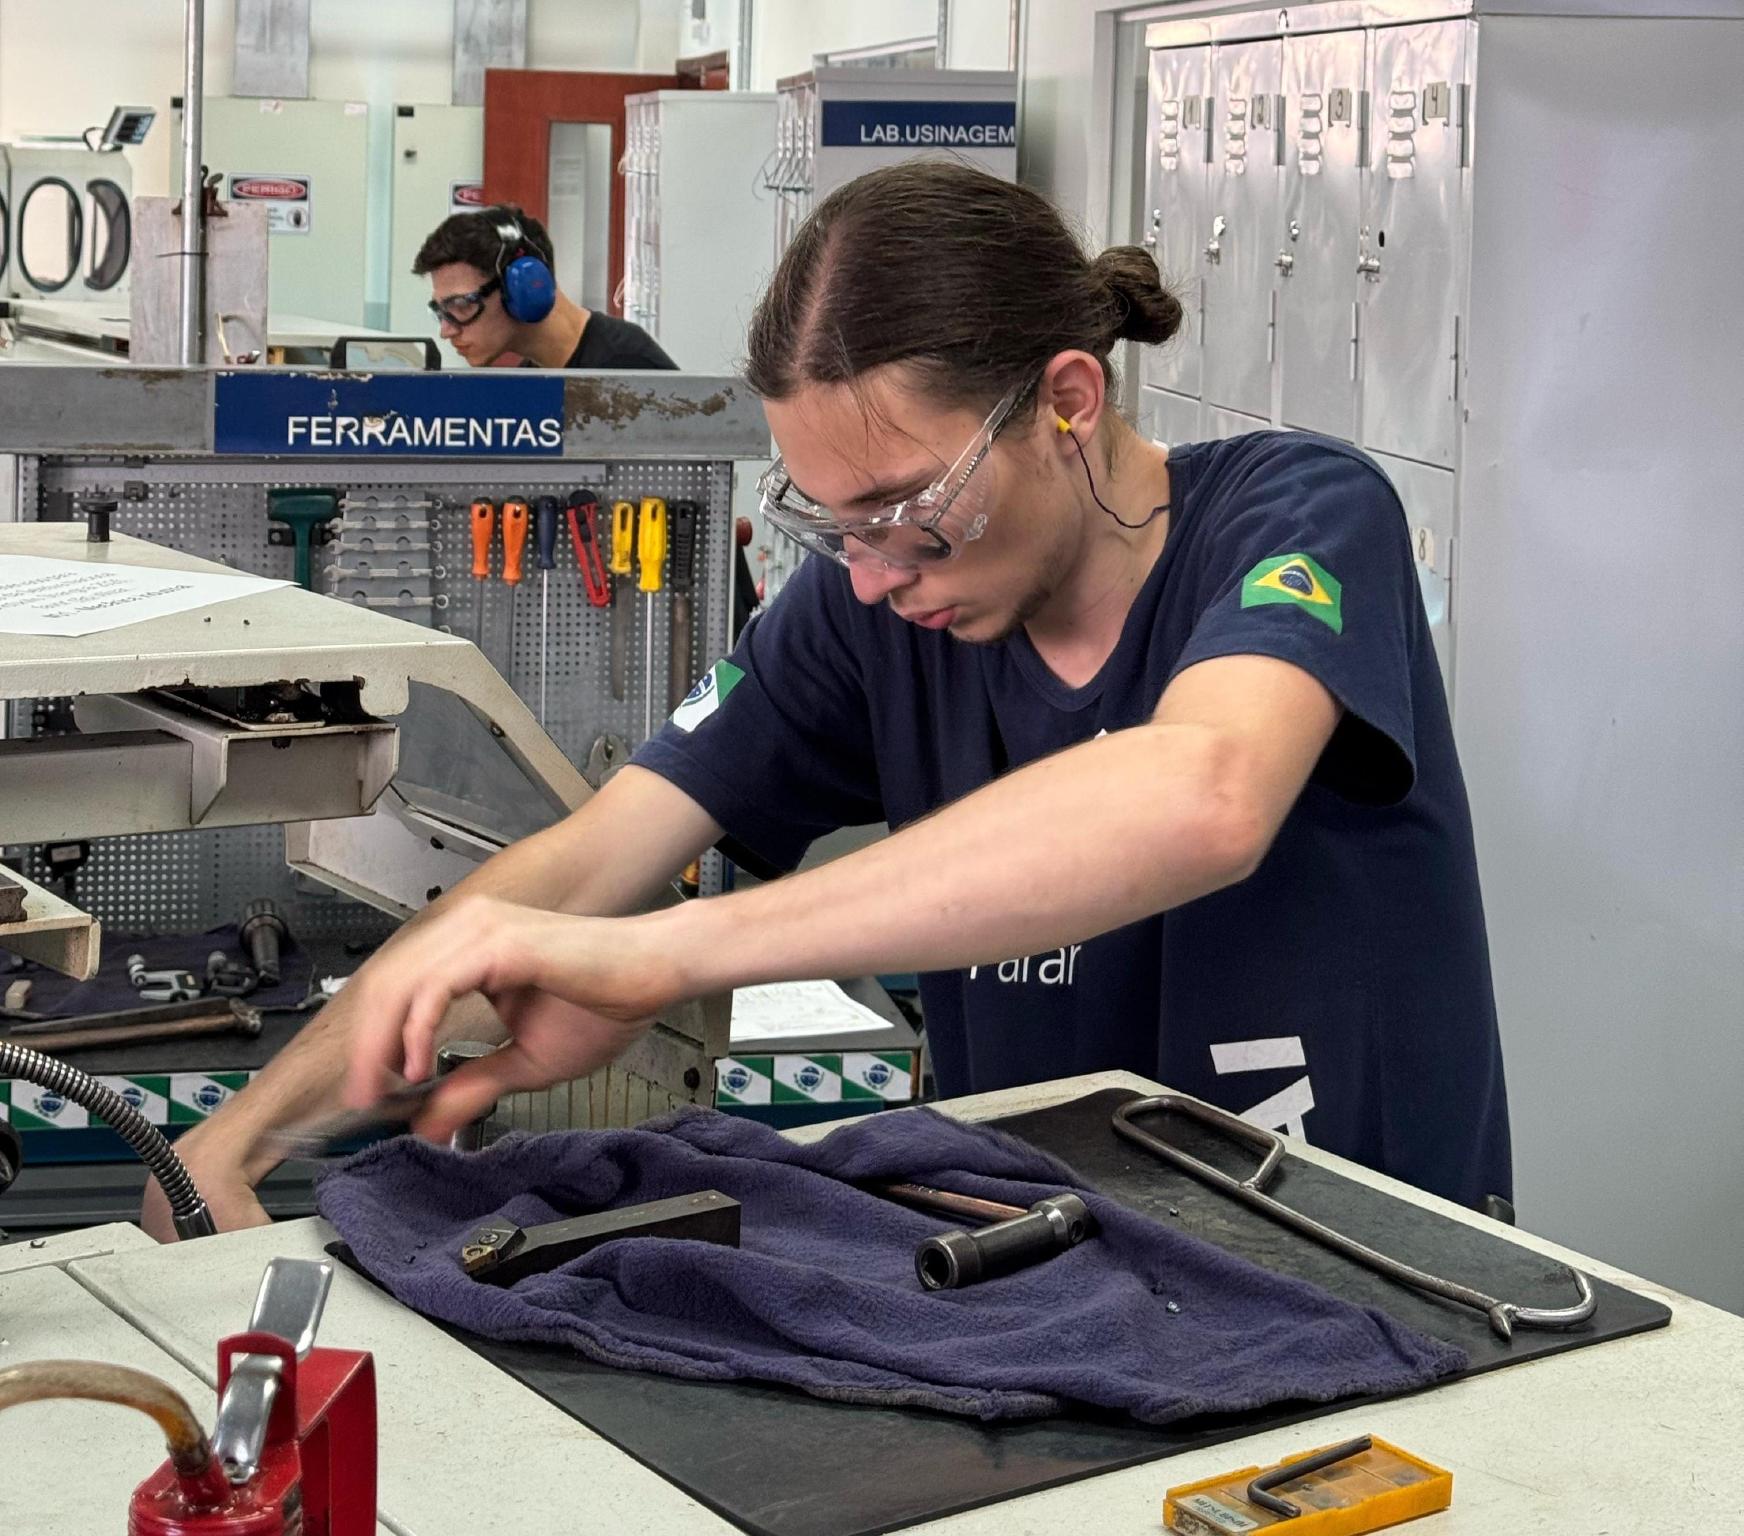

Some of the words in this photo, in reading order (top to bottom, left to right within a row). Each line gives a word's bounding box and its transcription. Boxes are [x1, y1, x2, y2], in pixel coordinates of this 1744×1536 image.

[1335, 89, 1344, 119] 3
[1431, 83, 1439, 115] 4
[288, 416, 561, 447] FERRAMENTAS
[1418, 528, 1426, 561] 8
